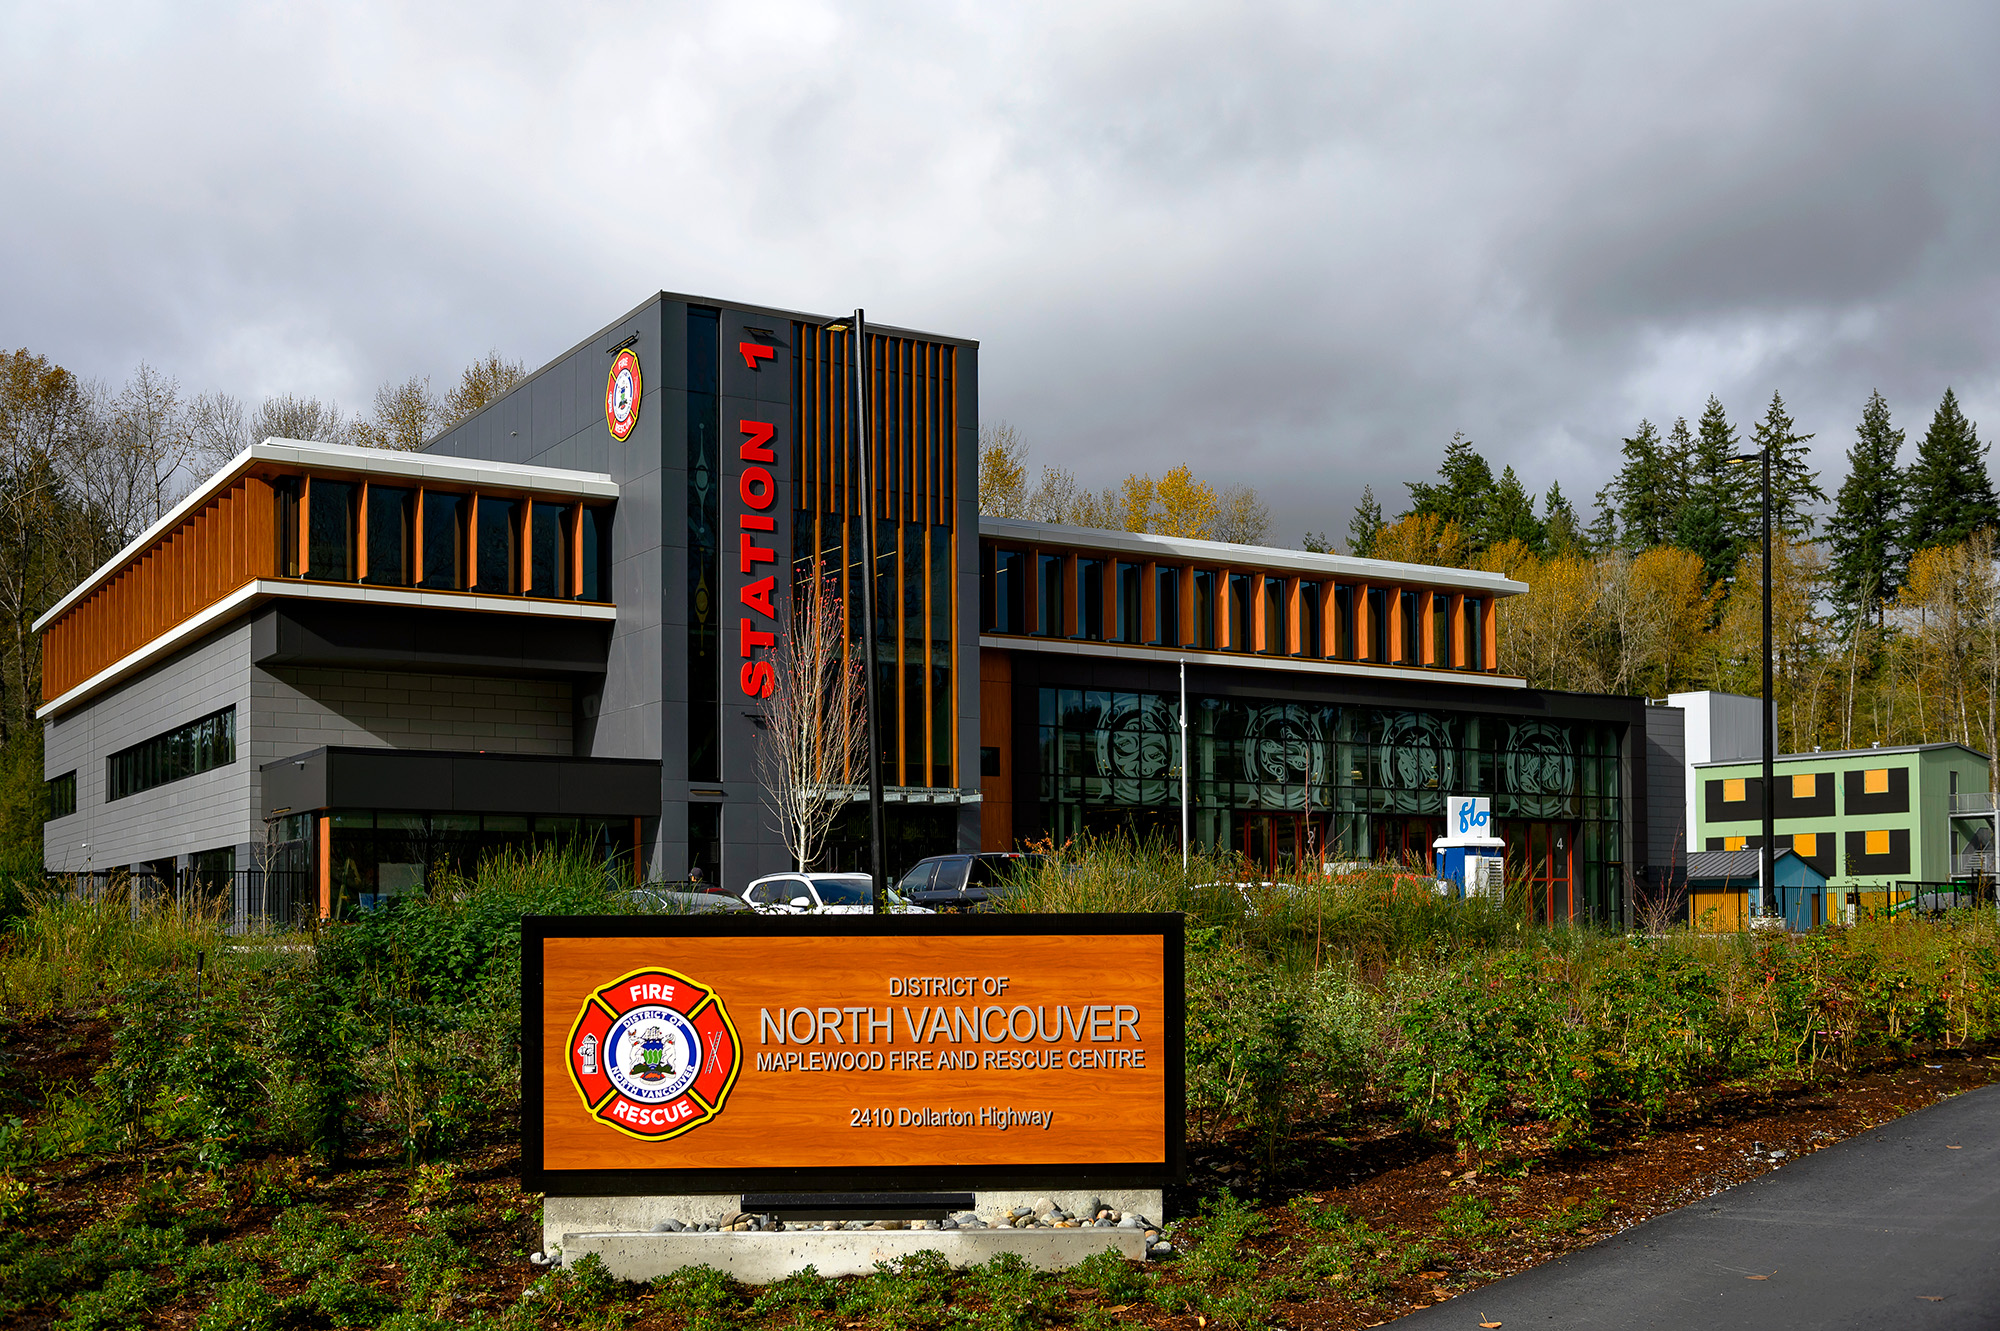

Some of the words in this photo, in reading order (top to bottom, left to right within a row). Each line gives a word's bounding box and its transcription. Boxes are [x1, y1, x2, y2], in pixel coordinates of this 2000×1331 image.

[739, 342, 774, 368] 1
[740, 420, 775, 699] STATION
[1458, 798, 1490, 833] flo
[1556, 837, 1564, 850] 4
[629, 983, 675, 1002] FIRE
[889, 977, 978, 997] DISTRICT
[982, 977, 1009, 996] OF
[623, 1010, 667, 1028] DISTRICT
[669, 1016, 682, 1028] OF
[760, 1007, 894, 1044] NORTH
[902, 1005, 1141, 1043] VANCOUVER
[756, 1051, 884, 1072] MAPLEWOOD
[890, 1051, 932, 1071] FIRE
[937, 1050, 978, 1070] AND
[983, 1050, 1062, 1070] RESCUE
[1067, 1049, 1146, 1069] CENTRE
[611, 1066, 637, 1095] NORTH
[642, 1064, 695, 1099] VANCOUVER
[613, 1100, 693, 1125] RESCUE
[850, 1108, 894, 1128] 2410
[898, 1107, 975, 1127] Dollarton
[979, 1106, 1053, 1130] Highway
